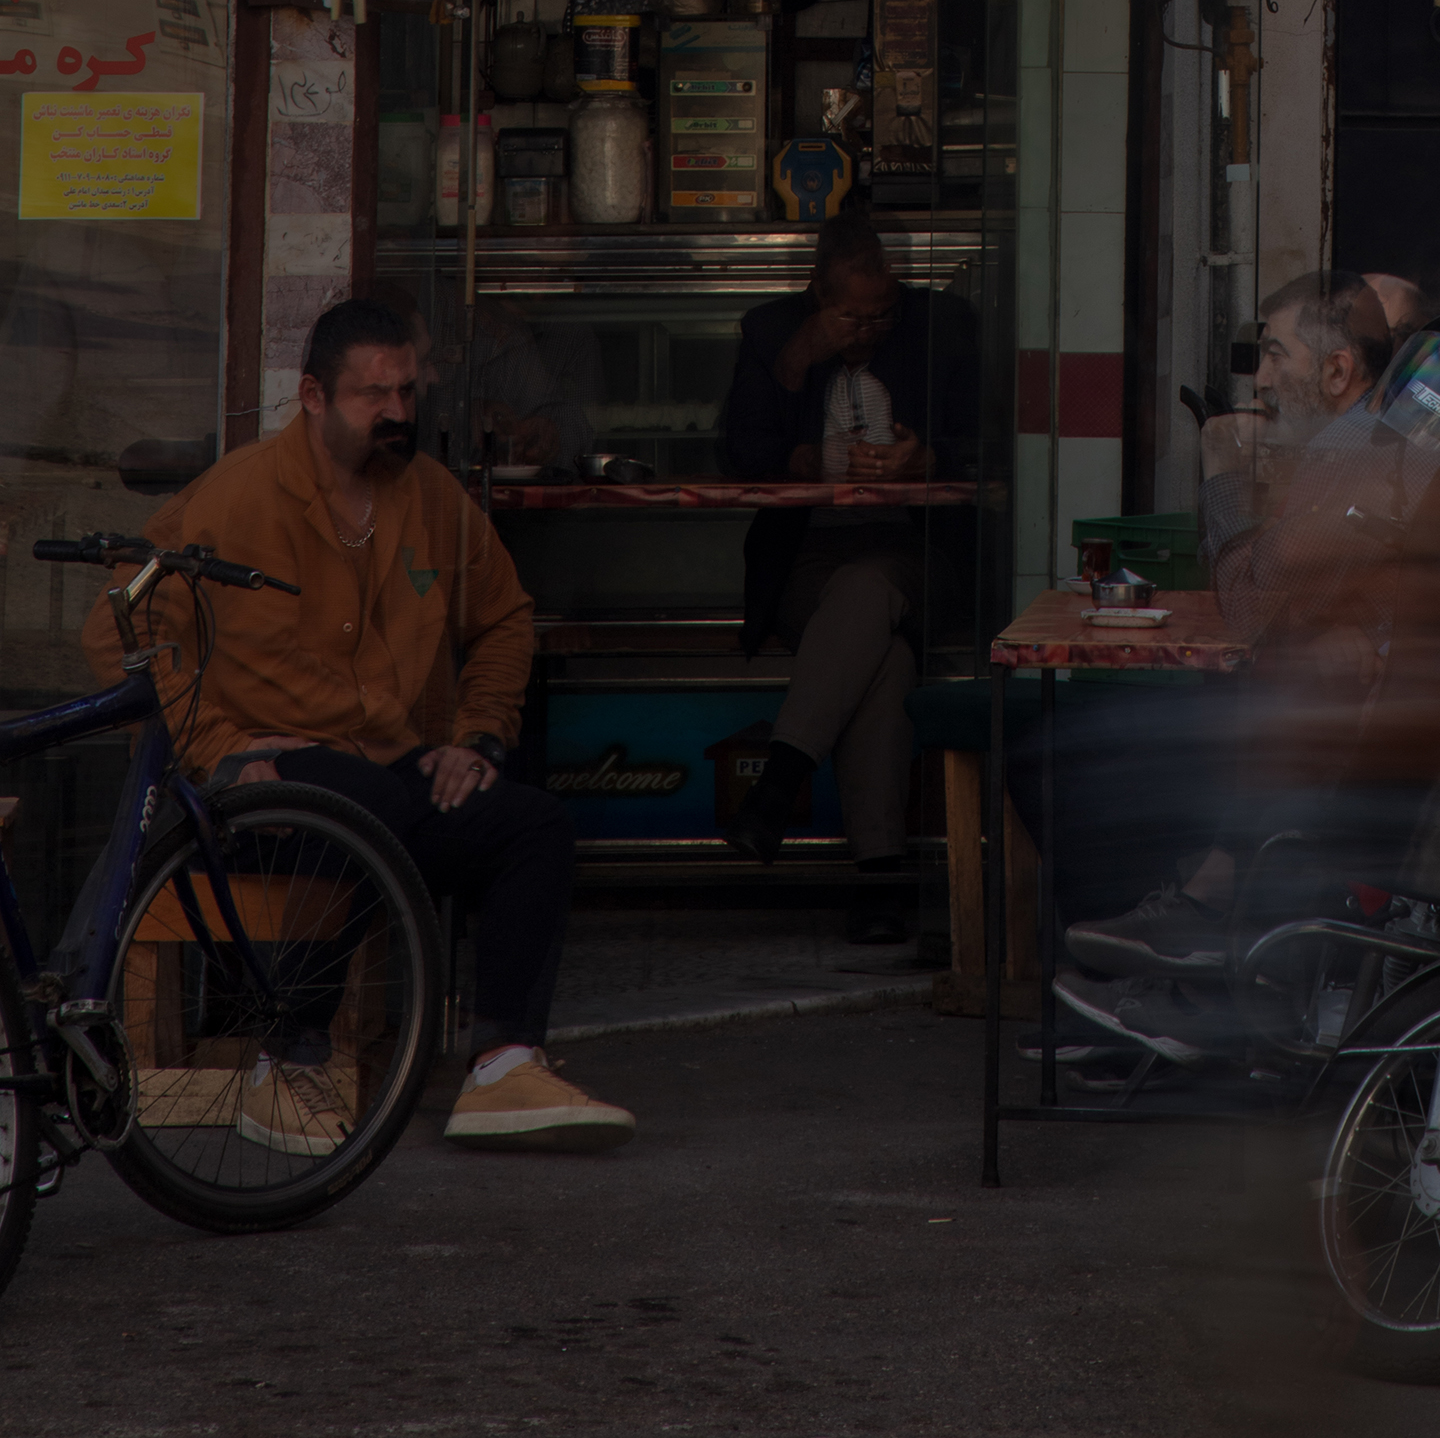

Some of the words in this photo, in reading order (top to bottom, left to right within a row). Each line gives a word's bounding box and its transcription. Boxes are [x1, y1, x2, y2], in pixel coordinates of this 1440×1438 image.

[57, 30, 156, 91] کره
[32, 104, 57, 121] نباش
[59, 104, 94, 120] ماشینت
[96, 105, 121, 120] تعمیر
[122, 110, 133, 121] ی
[135, 106, 160, 121] هزینه
[162, 105, 191, 121] نگران
[52, 125, 84, 141] کن
[86, 125, 131, 141] حساب
[133, 125, 173, 142] قسطی
[49, 147, 81, 163] منتخب
[148, 146, 171, 163] گروه
[146, 172, 165, 183] شماره
[62, 186, 76, 197] علی
[76, 186, 90, 196] امام
[91, 186, 109, 196] میدان
[110, 187, 126, 196] رشت
[545, 753, 682, 791] welcome
